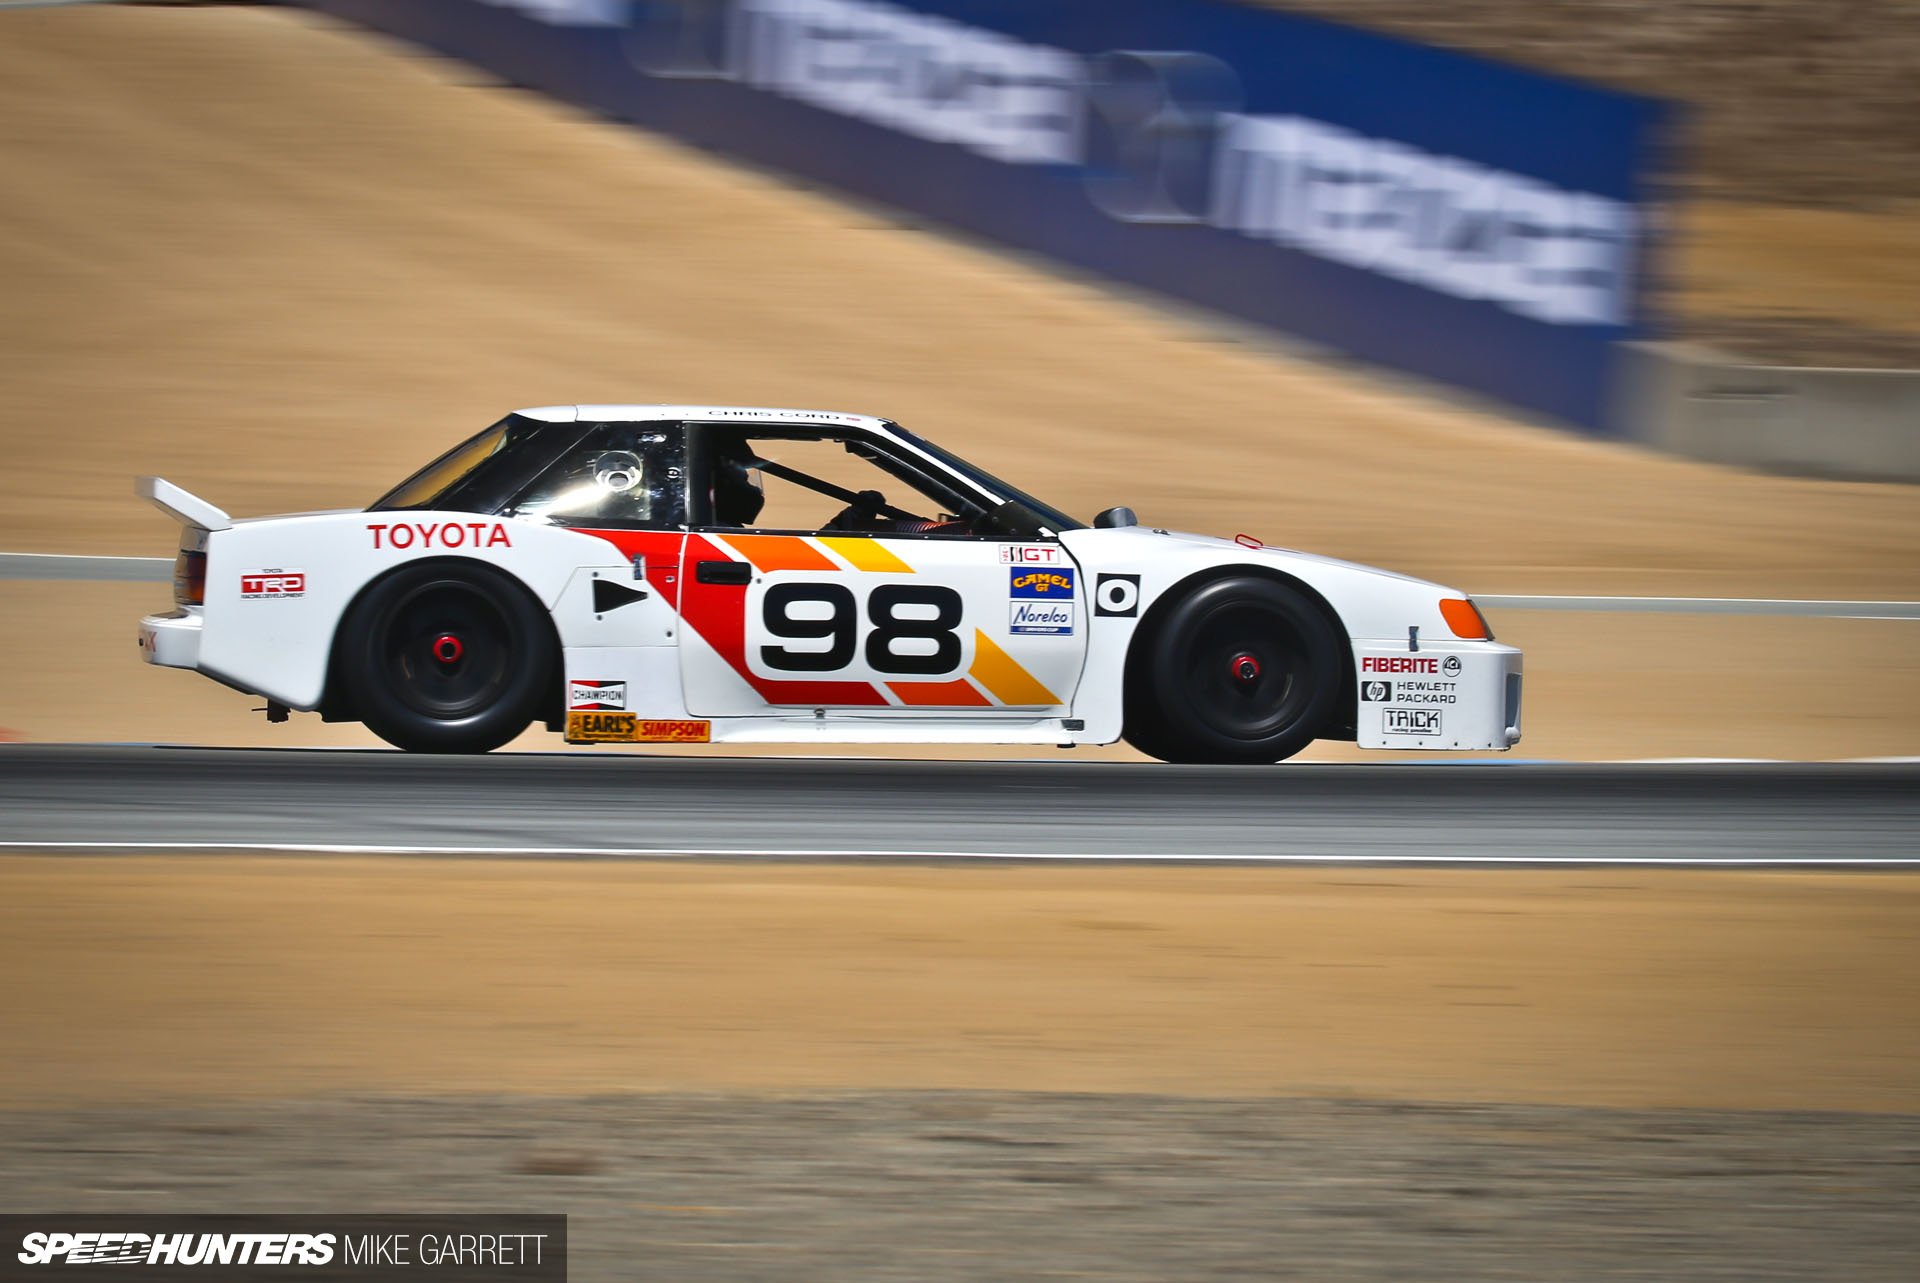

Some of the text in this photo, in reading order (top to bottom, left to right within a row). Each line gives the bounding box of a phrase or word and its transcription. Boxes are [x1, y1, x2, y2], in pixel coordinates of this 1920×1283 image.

[366, 523, 512, 549] TOYOTA
[242, 577, 303, 593] TRD
[1012, 573, 1073, 589] CAMEL
[1034, 583, 1051, 593] GT
[1012, 604, 1069, 625] Norelco
[760, 582, 963, 675] 98
[1361, 656, 1439, 674] FIBERITE
[572, 689, 624, 701] CHAMPION
[1396, 681, 1457, 692] HEWLETT
[1396, 693, 1457, 704] PACKARD
[582, 714, 637, 734] EARL'S
[641, 721, 707, 737] SIMPSON
[1385, 710, 1440, 728] TRICK
